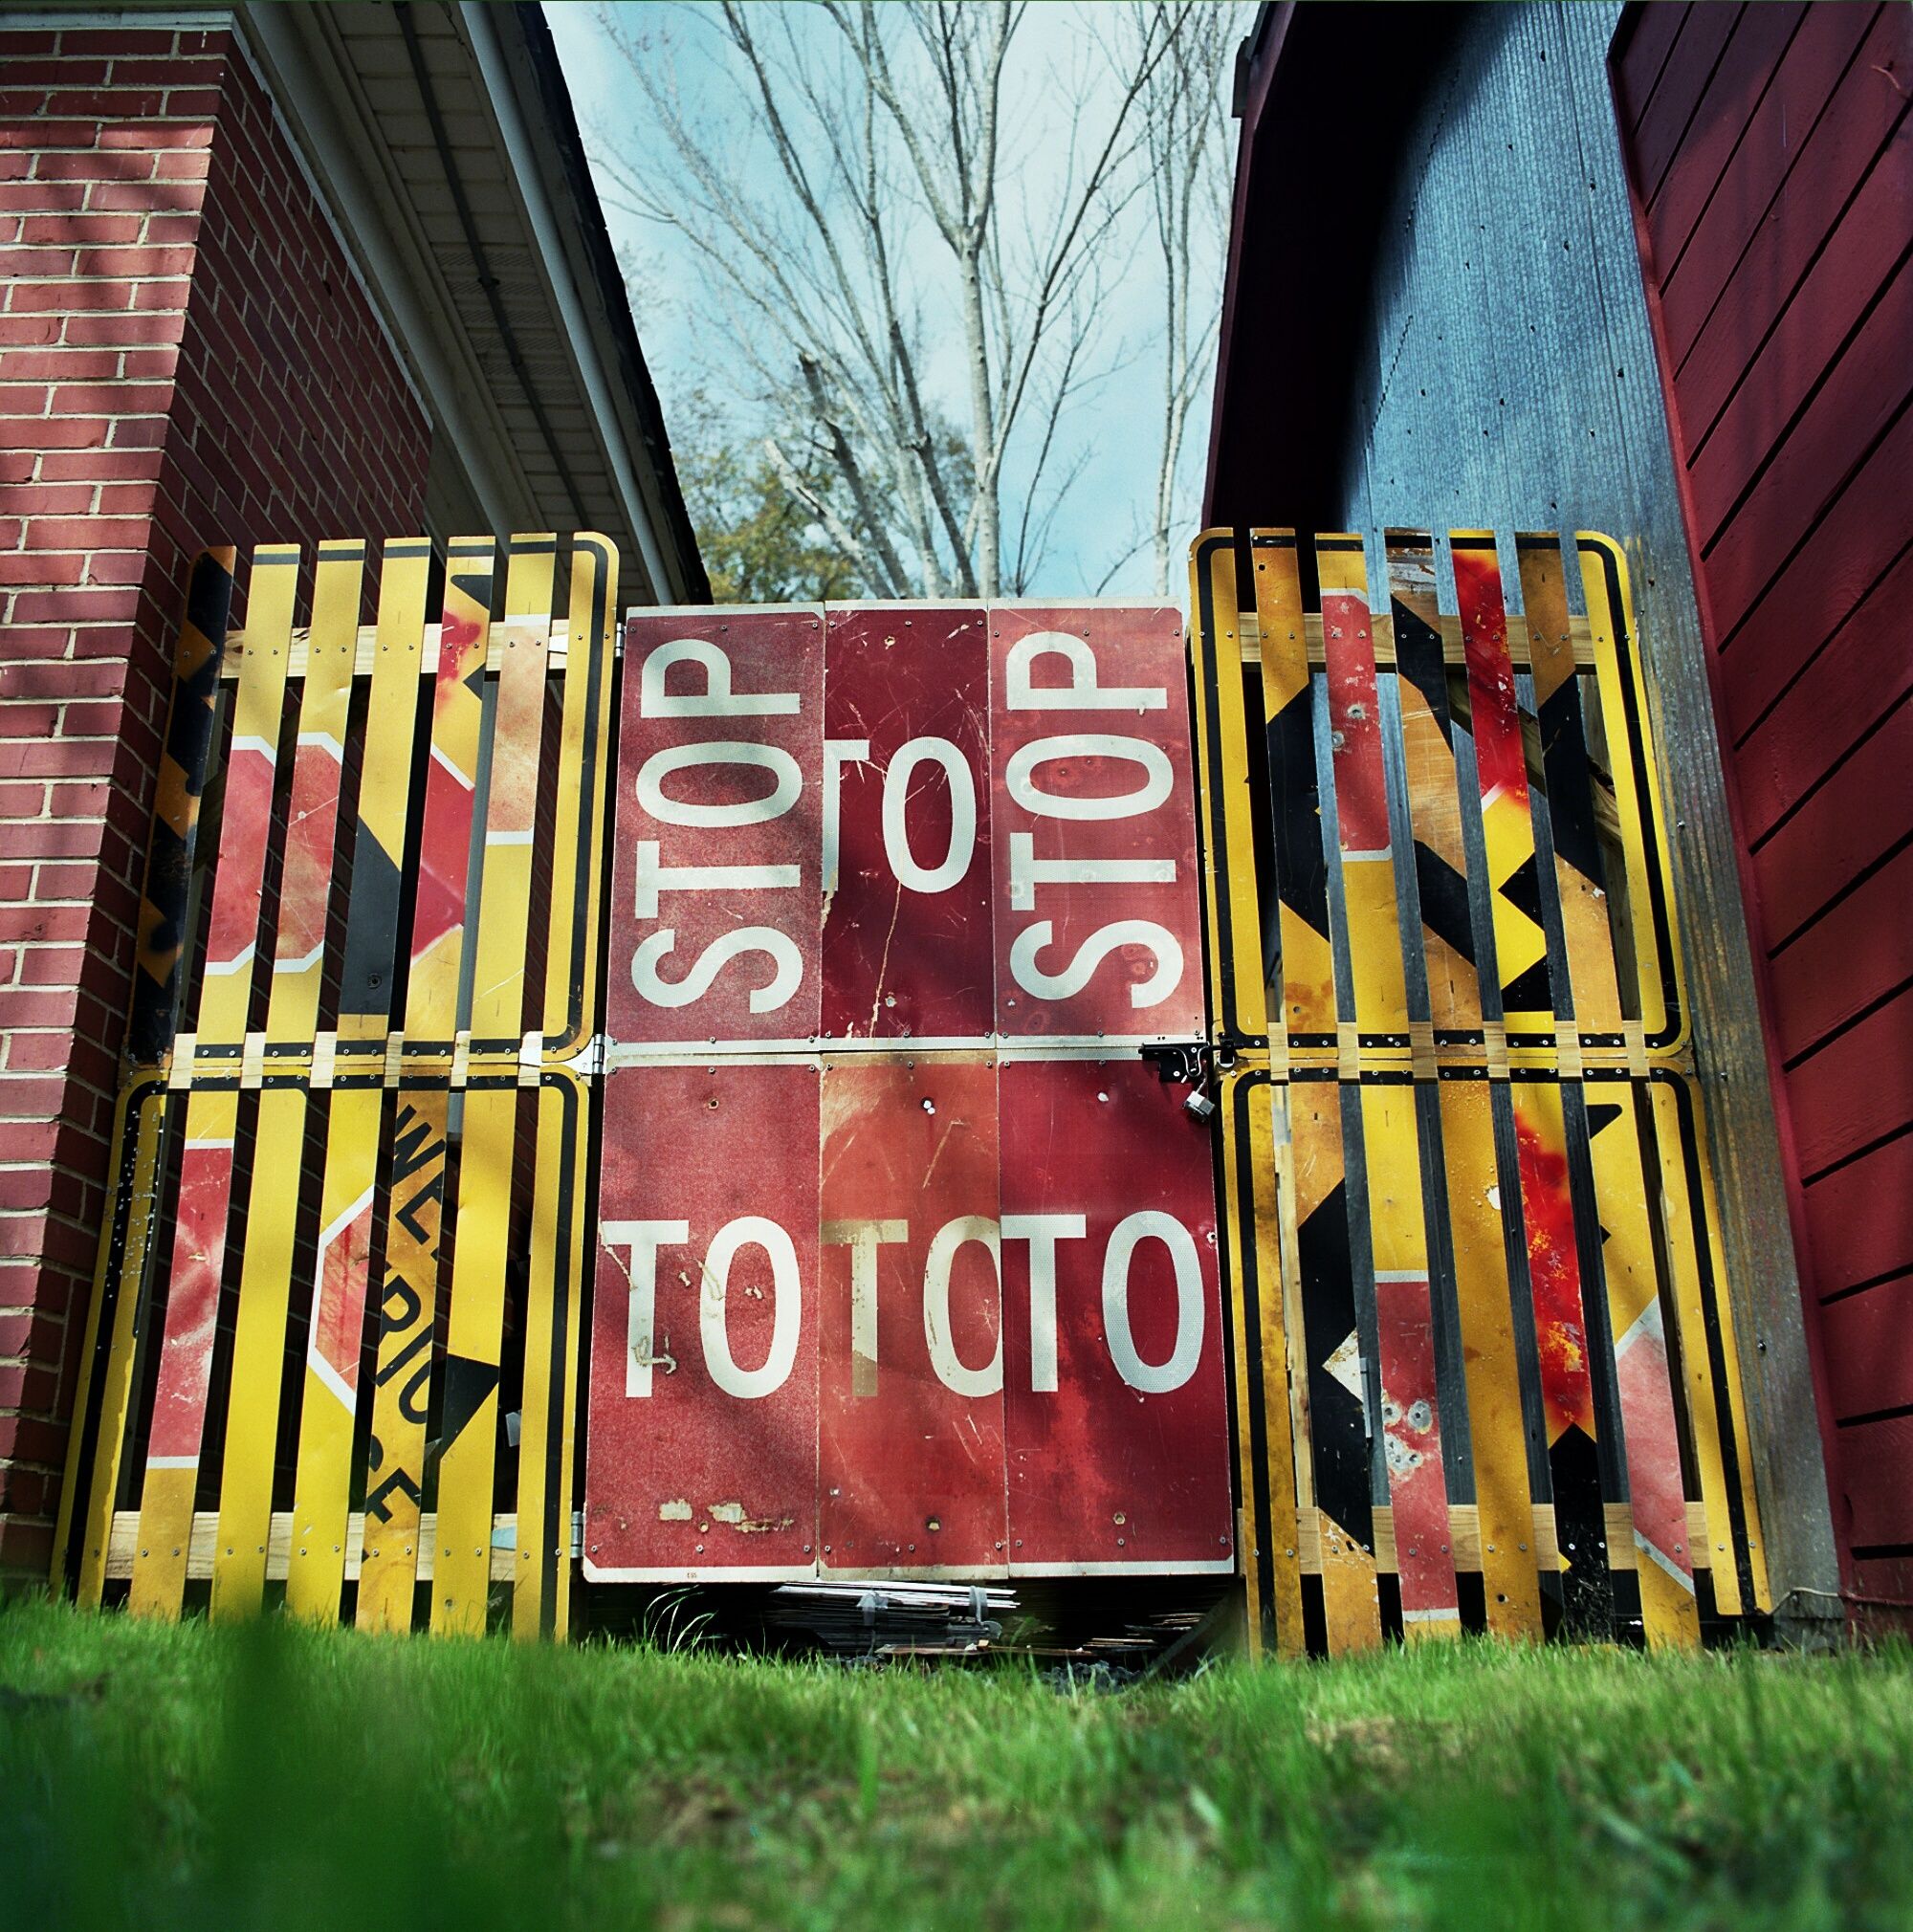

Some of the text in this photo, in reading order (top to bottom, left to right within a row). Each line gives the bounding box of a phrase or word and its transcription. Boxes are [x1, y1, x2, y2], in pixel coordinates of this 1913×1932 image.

[631, 638, 803, 1014] STOP
[1005, 631, 1184, 1009] STOP
[599, 1216, 802, 1399] TO
[821, 1216, 1002, 1398] TO
[1001, 1210, 1205, 1394] TO
